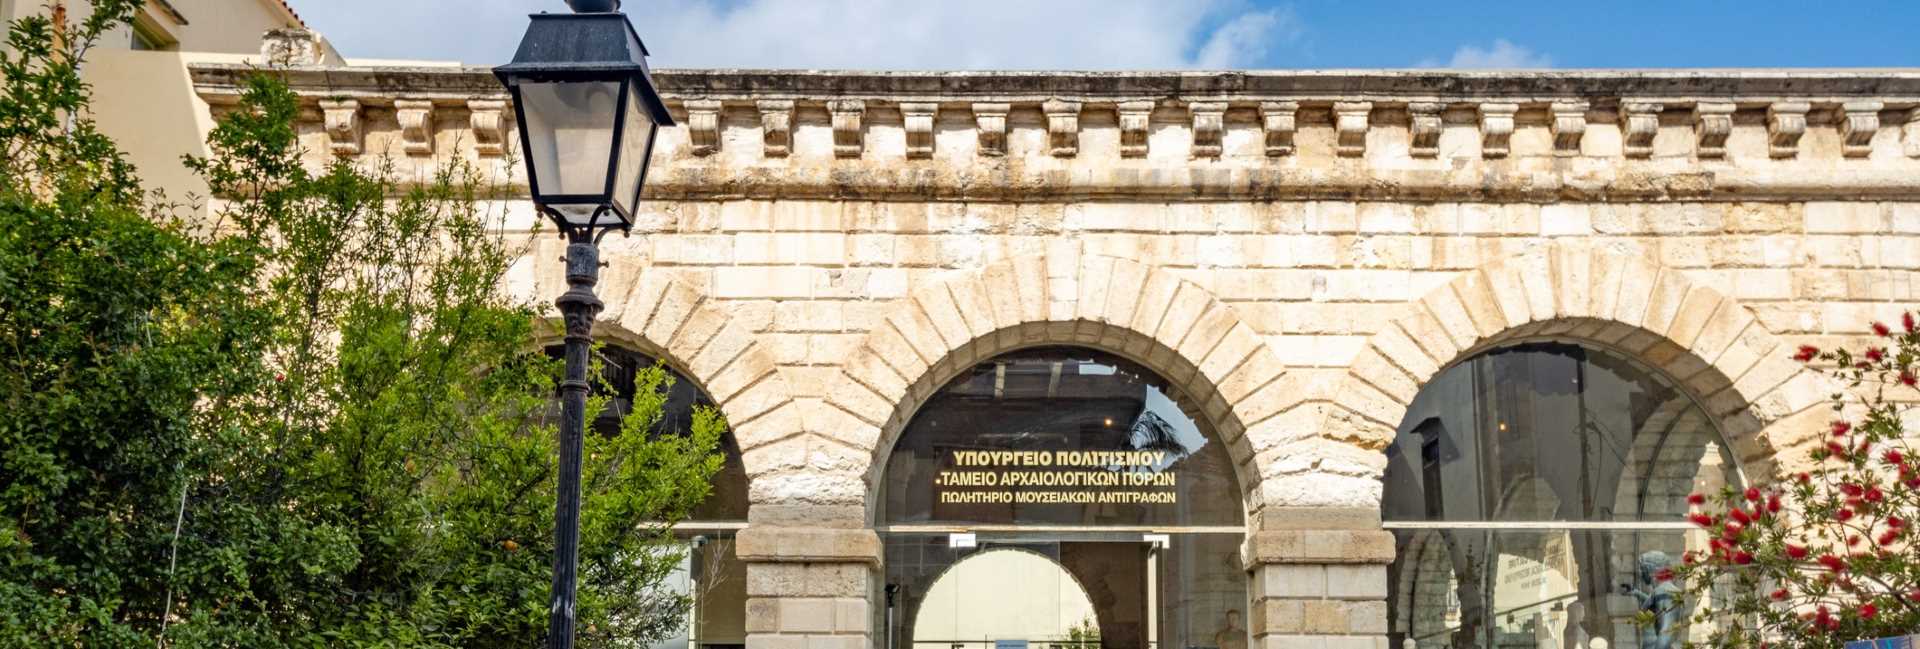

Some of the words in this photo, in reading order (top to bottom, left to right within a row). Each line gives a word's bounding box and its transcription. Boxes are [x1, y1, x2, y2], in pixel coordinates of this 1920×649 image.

[953, 451, 1053, 466] ΥΠΟΥΡΓΕΙΟ
[1056, 451, 1165, 466] ΠΟΛΙΤΙΣΜΟΥ
[940, 471, 997, 486] ΤΑΜΕΙΟ
[1000, 471, 1119, 486] ΑΡΧΑΙΟΛΟΓΙΚΩΝ
[1123, 471, 1176, 486] ΠΟΡΩΝ
[941, 491, 1013, 503] ΠΩΛΗΤΗΡΙΟ
[1015, 491, 1095, 503] ΜΟΥΣΕΙΑΚΩΝ
[1098, 491, 1176, 503] ΑΝΤΙΓΡΑΦΩΝ
